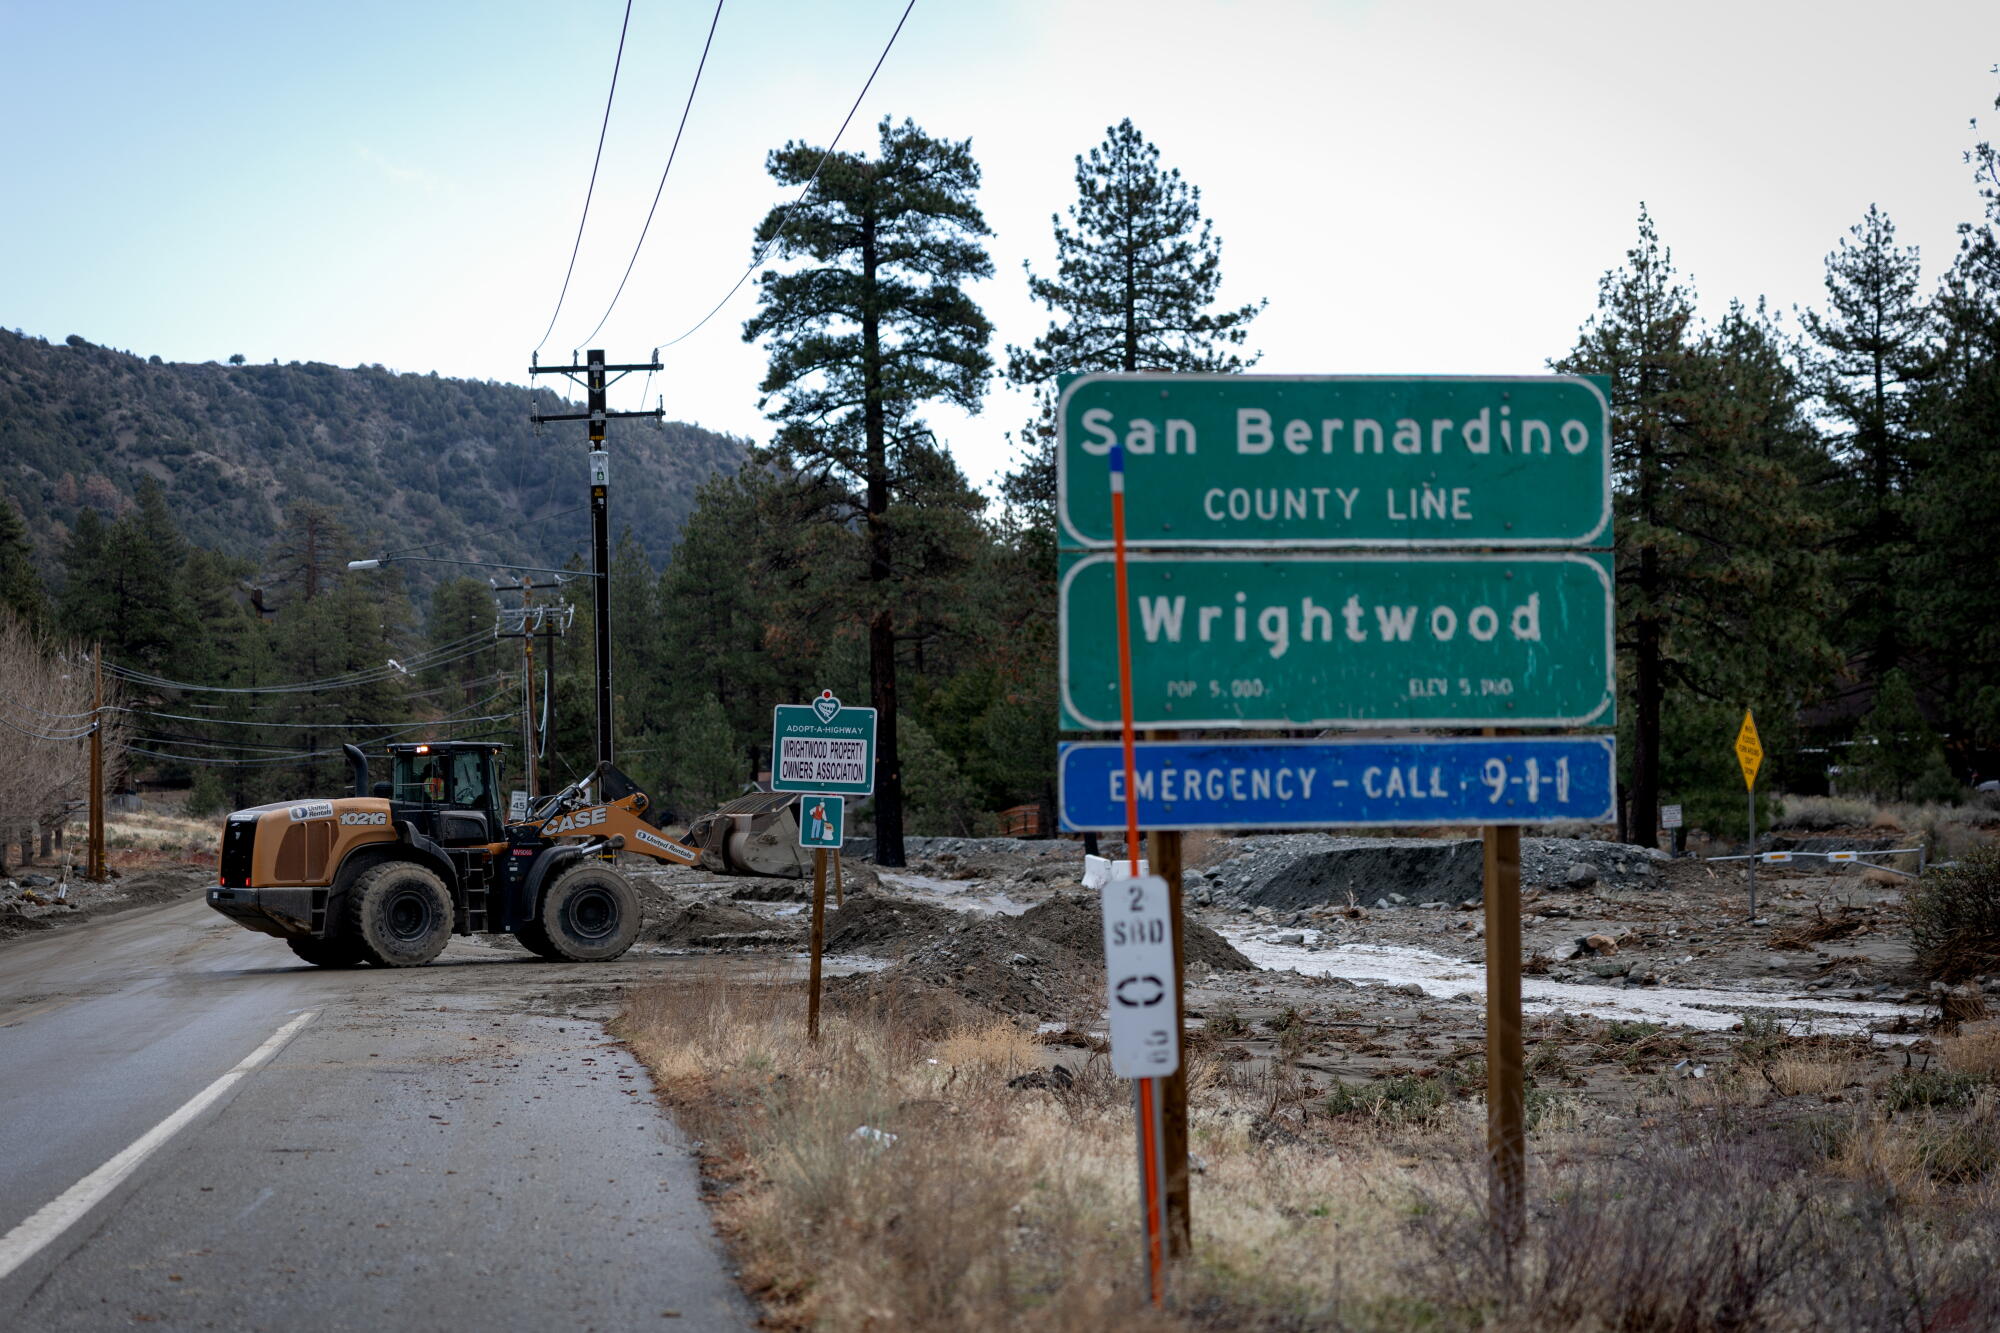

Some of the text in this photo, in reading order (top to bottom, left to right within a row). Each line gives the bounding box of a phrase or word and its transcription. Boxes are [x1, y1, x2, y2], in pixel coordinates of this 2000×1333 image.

[1081, 405, 1590, 456] San Bernardino
[1203, 486, 1473, 521] COUNTY LINE
[1138, 591, 1542, 659] Wrightwood
[1167, 679, 1197, 698] POP
[1408, 677, 1448, 697] ELEV
[786, 724, 864, 735] ADOPT-A-HIGHWAY
[783, 739, 864, 761] WRIGHTWOOD PROPERTY
[782, 760, 864, 781] OWNERS ASSOCIATION
[1109, 767, 1317, 802] EMERGENCY
[1362, 765, 1449, 800] CALL
[1479, 756, 1570, 804] 9-1-1
[307, 804, 329, 812] United
[308, 809, 332, 818] Rentals
[512, 801, 526, 810] 45
[339, 812, 387, 825] 1021G
[541, 807, 608, 836] CASE
[646, 834, 693, 860] United Rentals
[1128, 886, 1144, 912] 2
